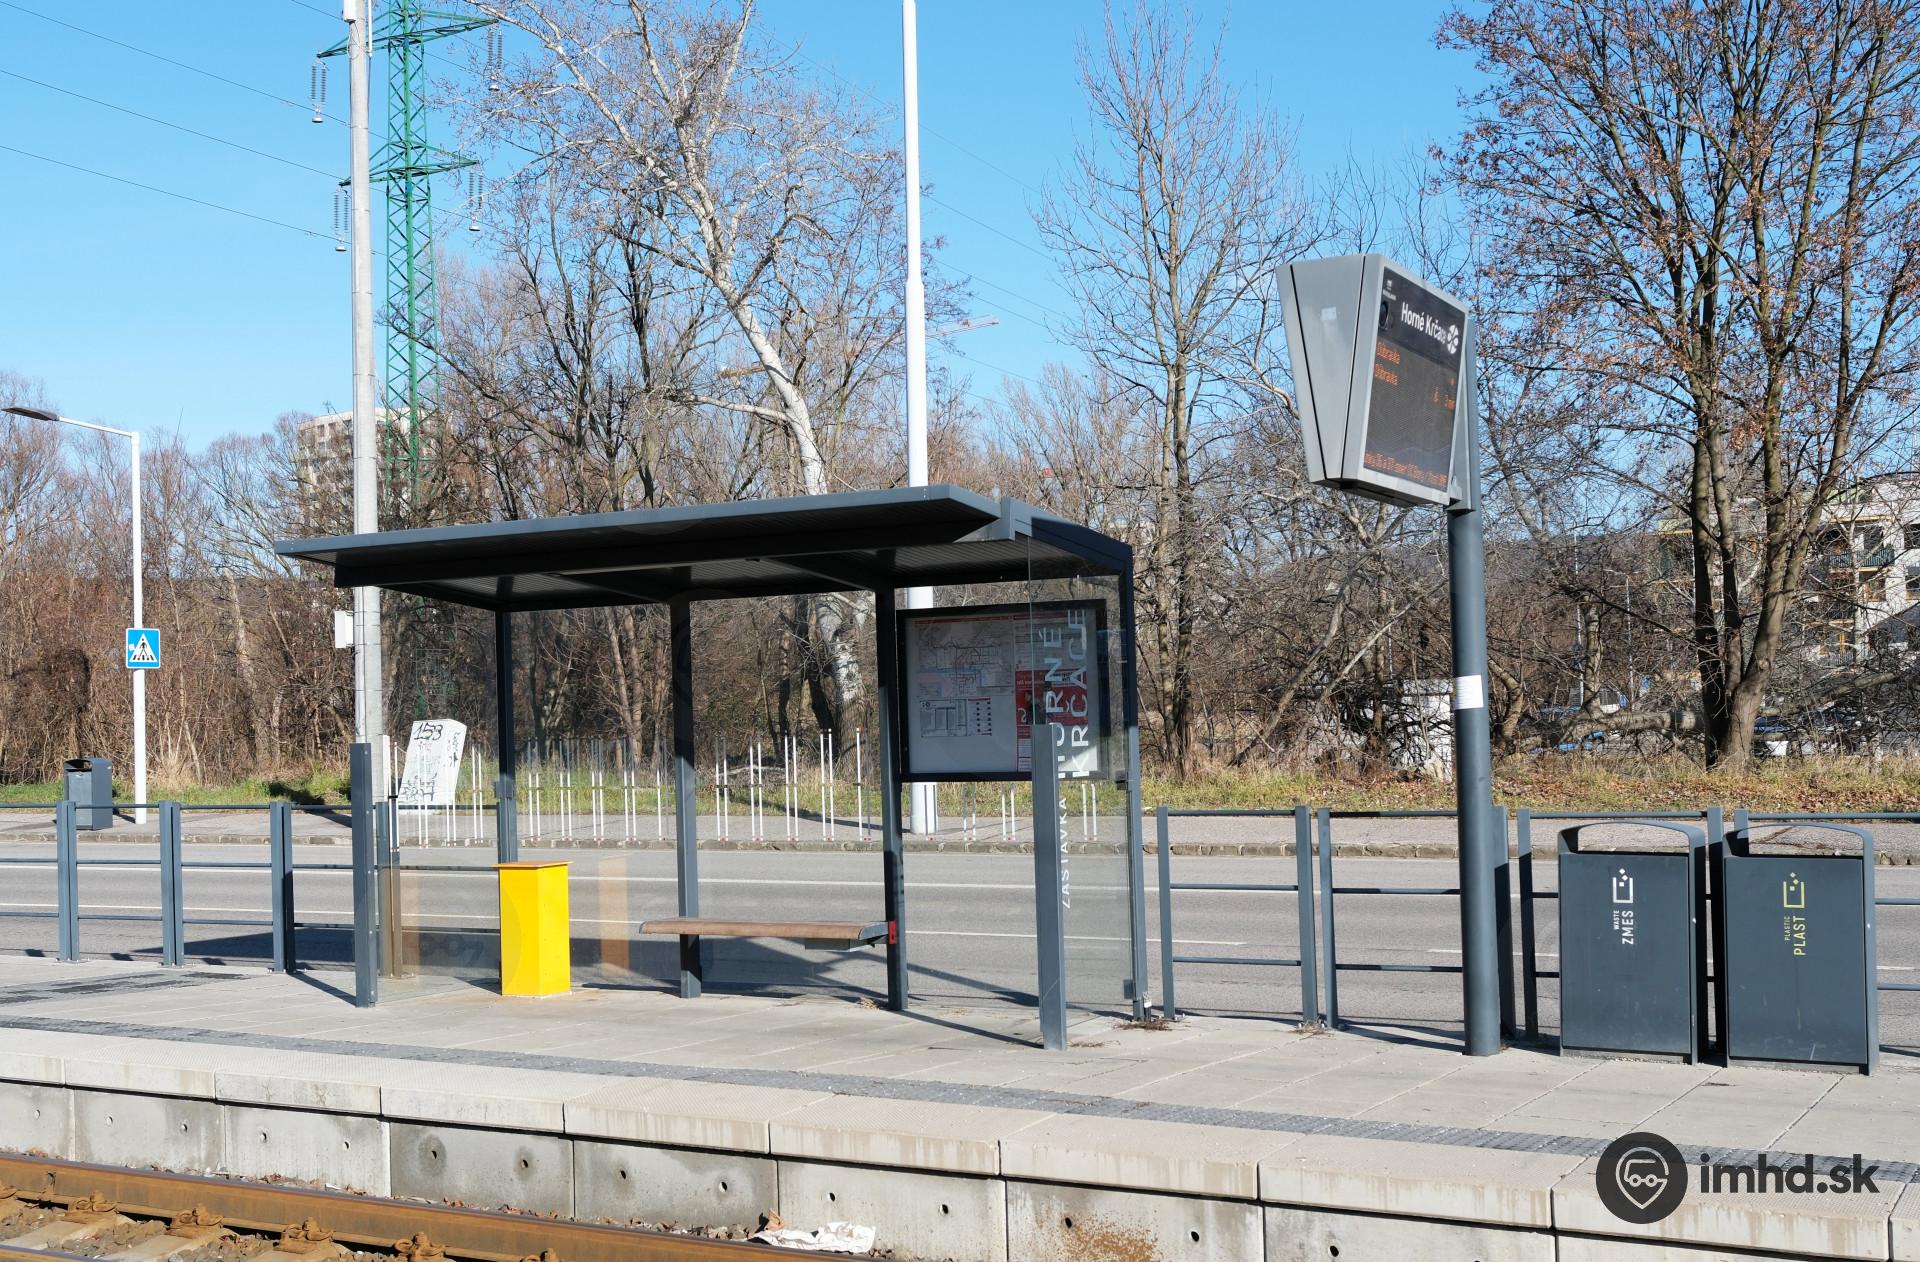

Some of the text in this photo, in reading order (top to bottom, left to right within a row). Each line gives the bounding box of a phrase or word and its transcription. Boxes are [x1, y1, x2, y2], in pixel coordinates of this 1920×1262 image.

[1401, 301, 1425, 332] Horné
[1066, 609, 1090, 778] KRČACE
[1621, 909, 1634, 945] ZMES
[1793, 915, 1806, 956] PLAST
